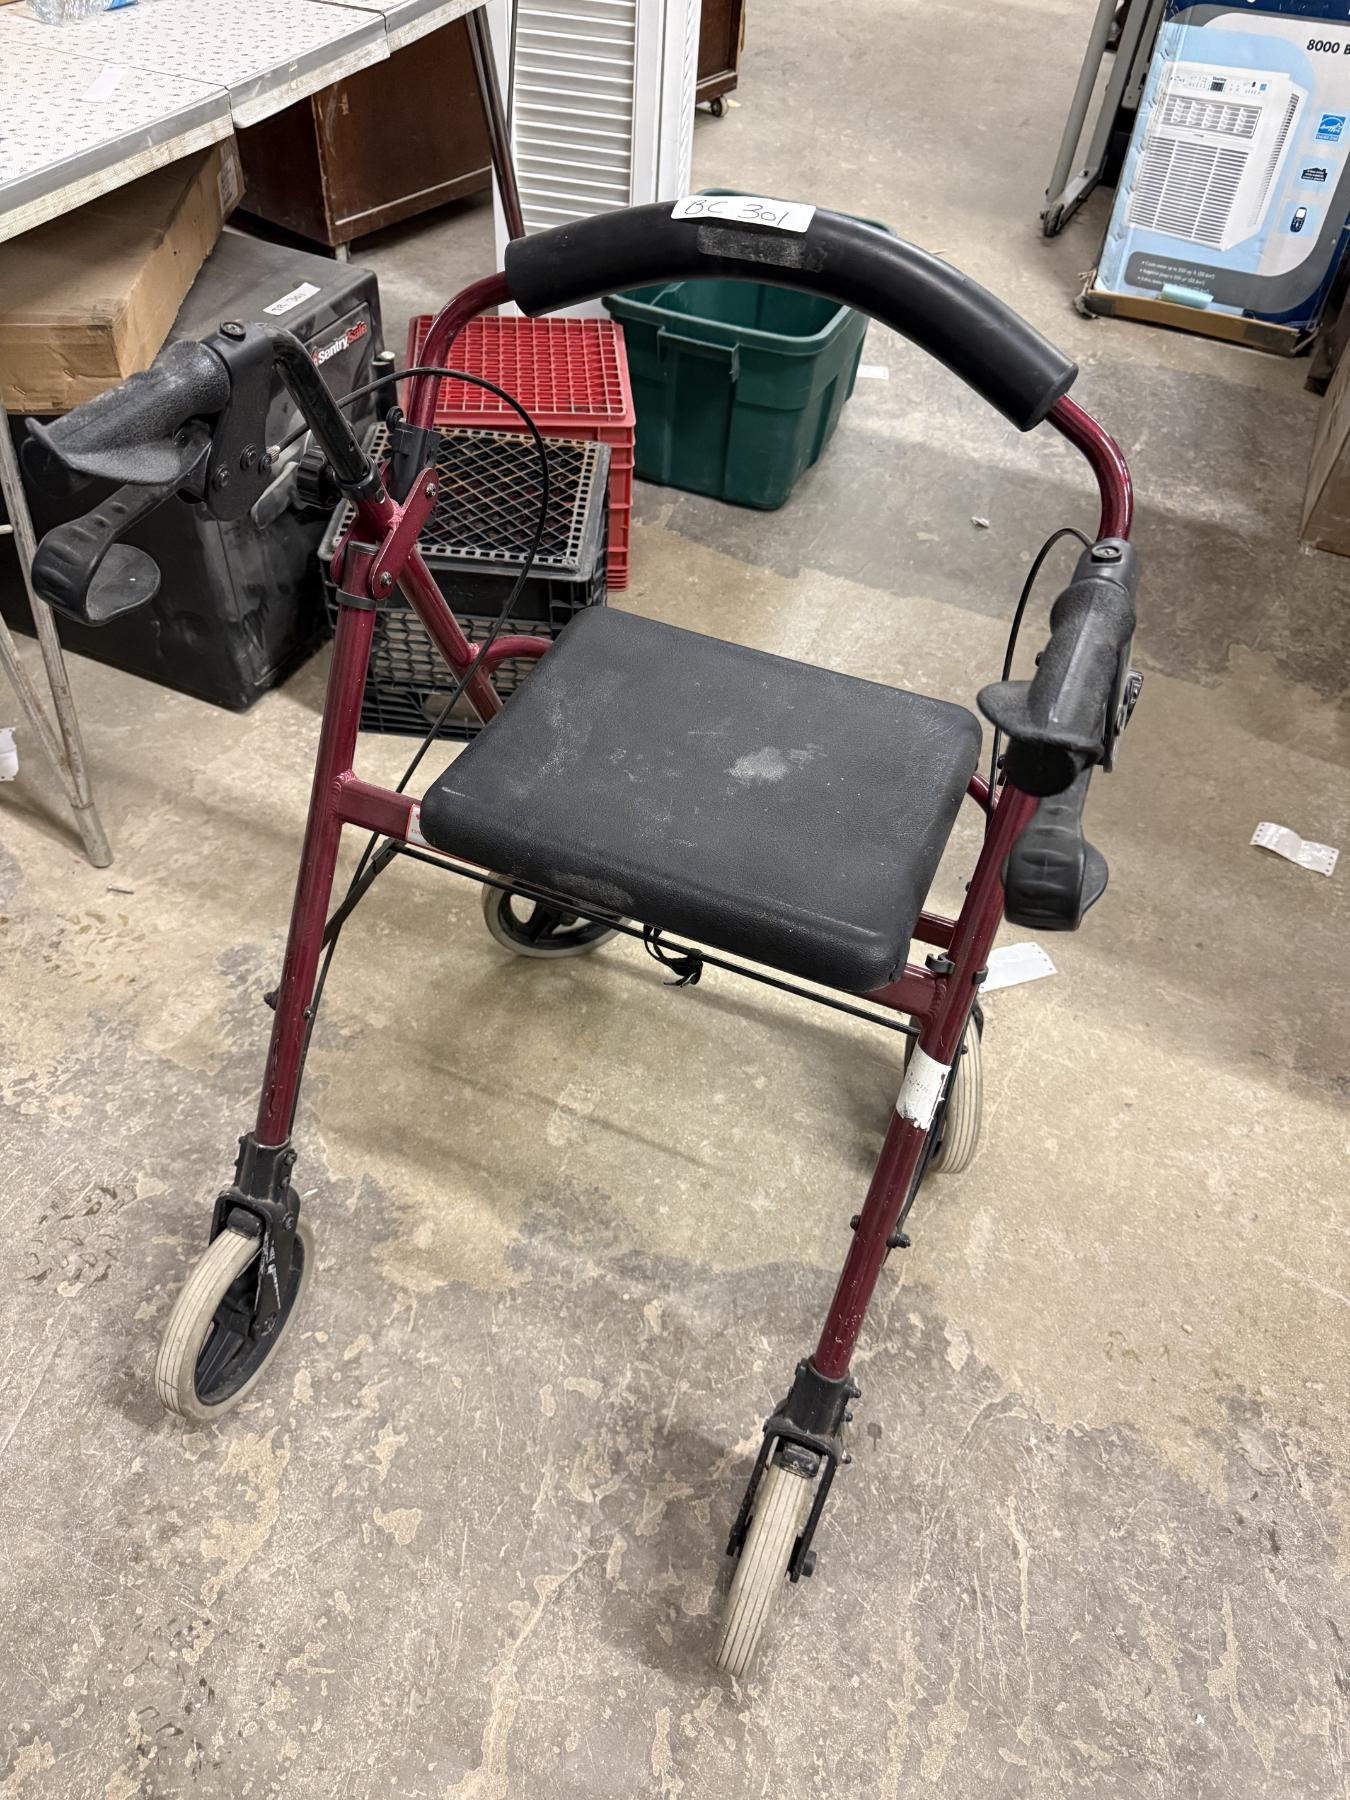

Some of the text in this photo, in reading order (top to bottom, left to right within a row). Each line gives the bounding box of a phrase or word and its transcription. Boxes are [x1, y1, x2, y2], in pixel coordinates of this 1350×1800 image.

[1306, 39, 1340, 54] 8000
[685, 199, 789, 226] BC 301
